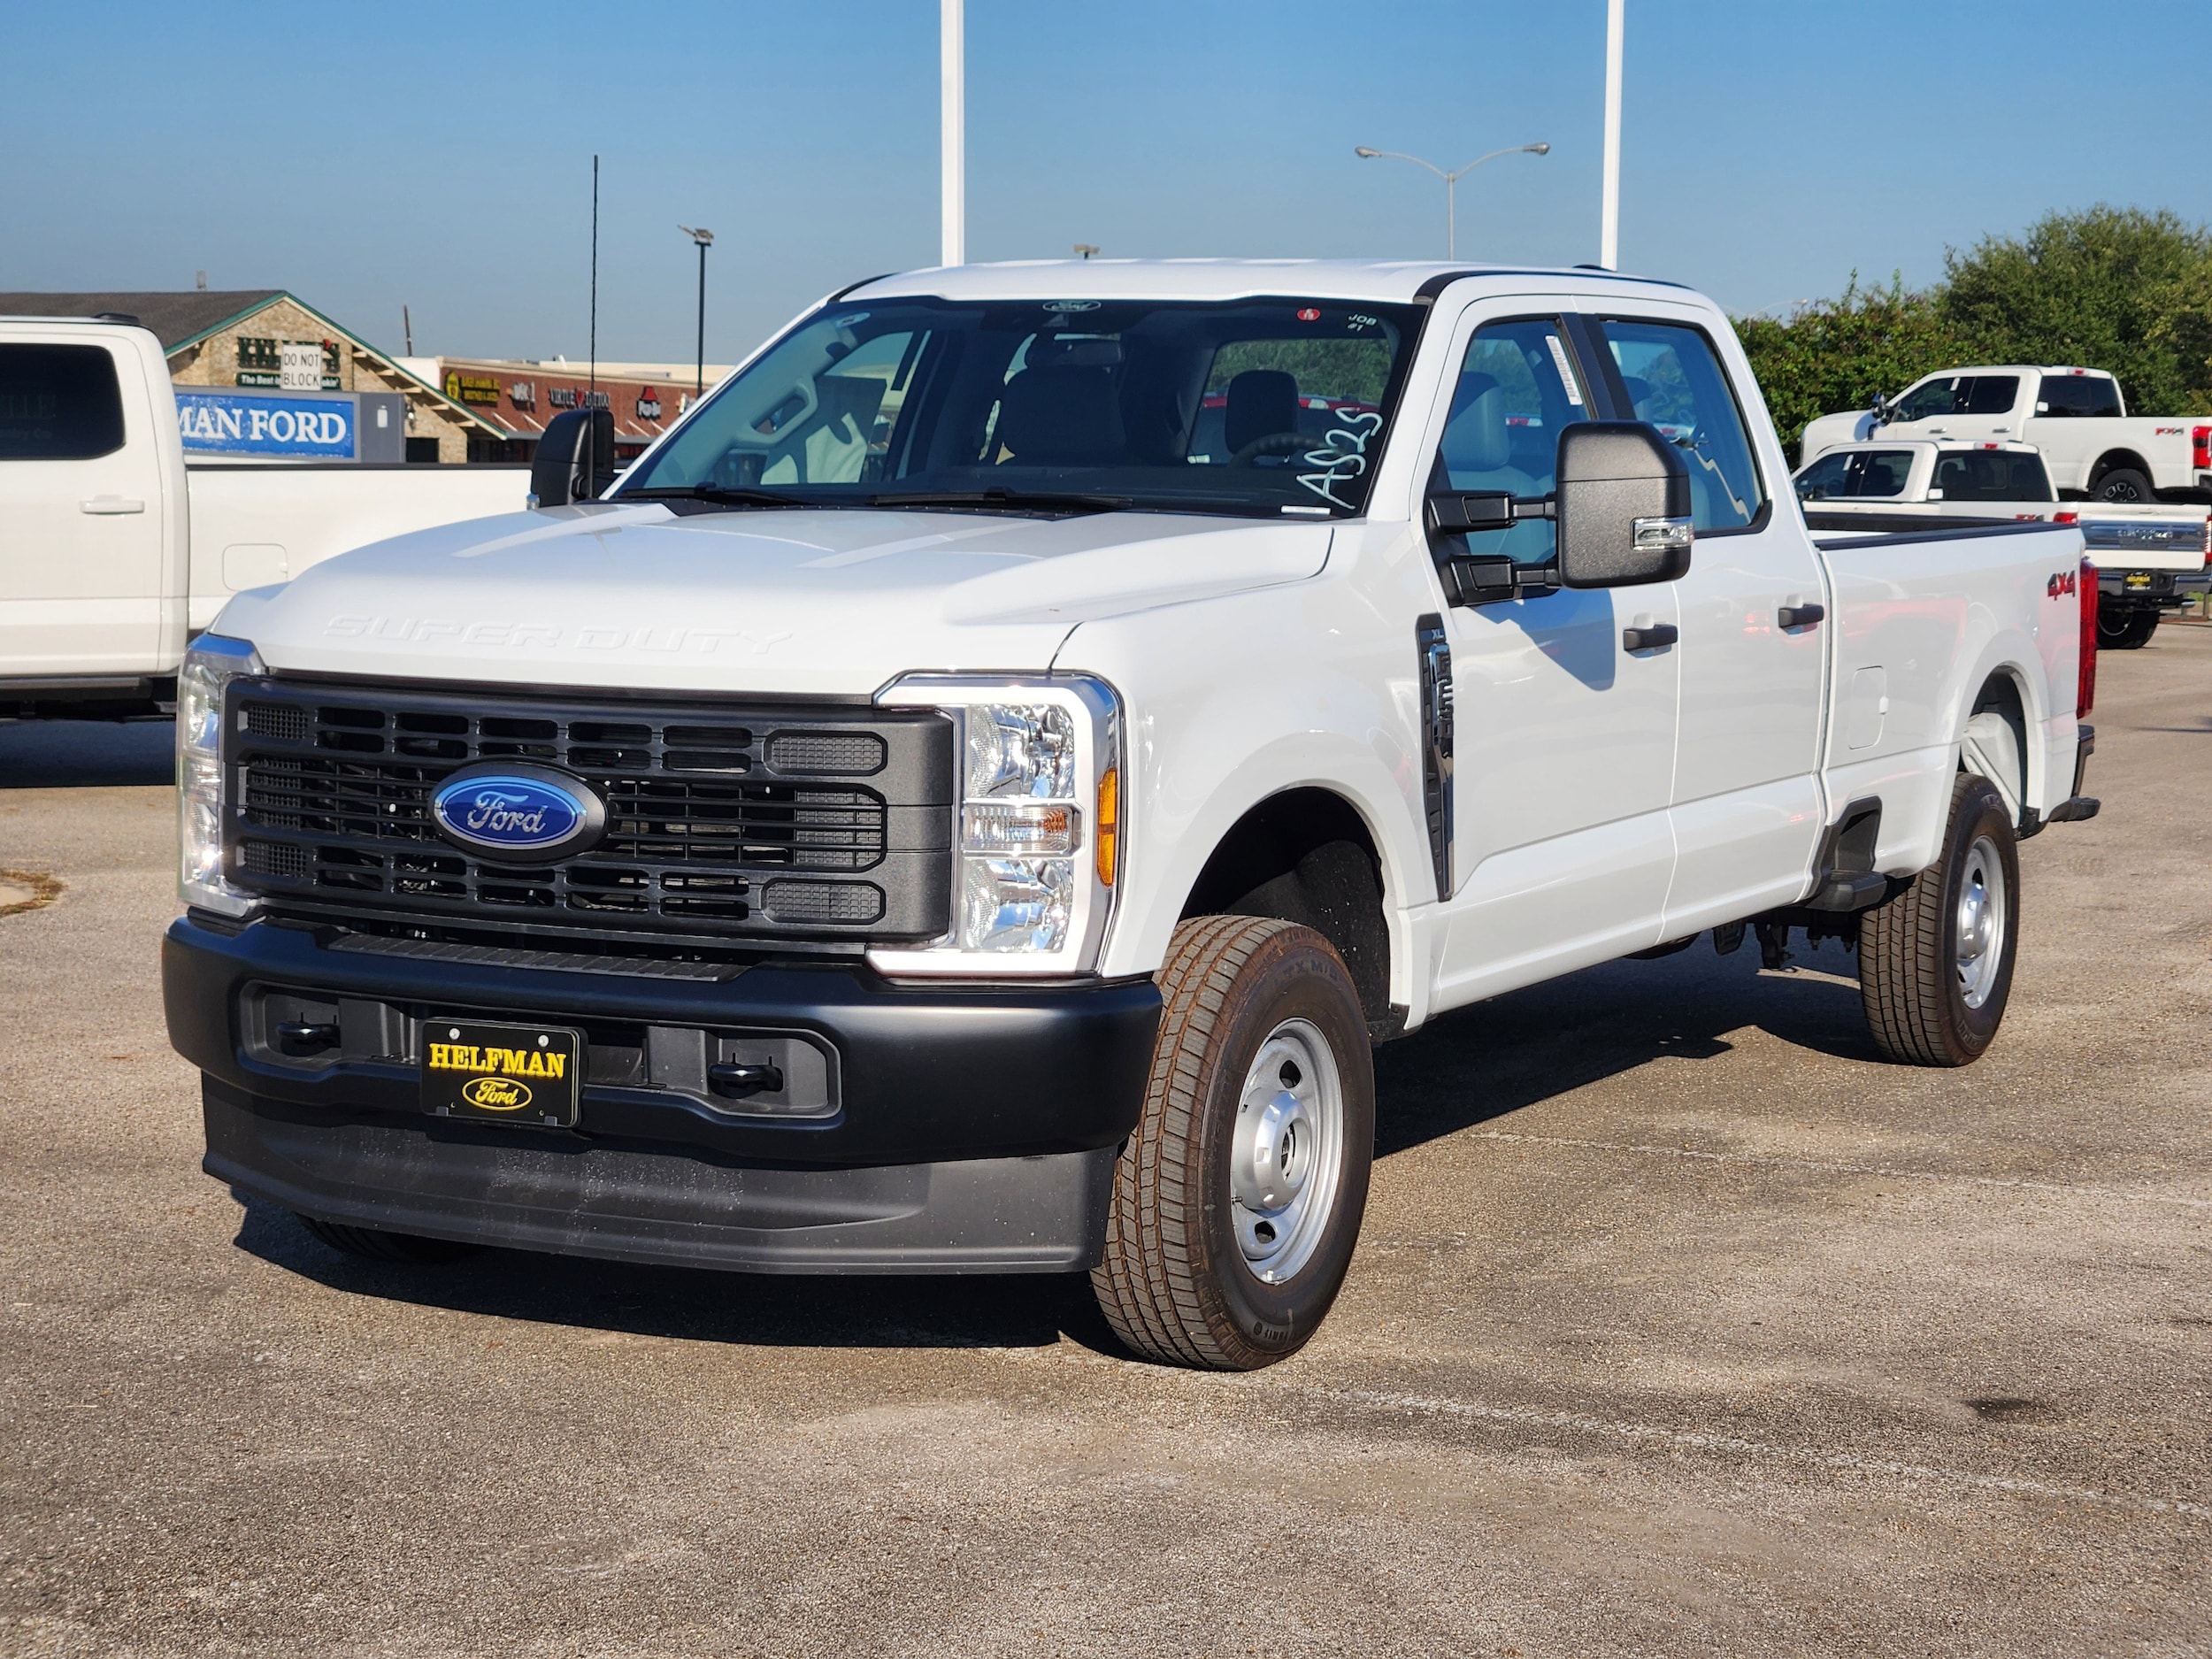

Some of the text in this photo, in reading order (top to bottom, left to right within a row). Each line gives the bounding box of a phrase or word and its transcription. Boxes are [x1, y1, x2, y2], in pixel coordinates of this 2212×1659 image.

[1348, 314, 1378, 326] JOB
[283, 352, 319, 366] DO NOT
[241, 374, 257, 384] The
[283, 372, 319, 387] BLOCK
[249, 408, 347, 444] FORD
[323, 614, 795, 656] SUPER DUTY
[1432, 628, 1445, 640] XL
[467, 790, 547, 834] Ford
[428, 1042, 567, 1079] HELFMAN
[474, 1079, 520, 1106] Ford
